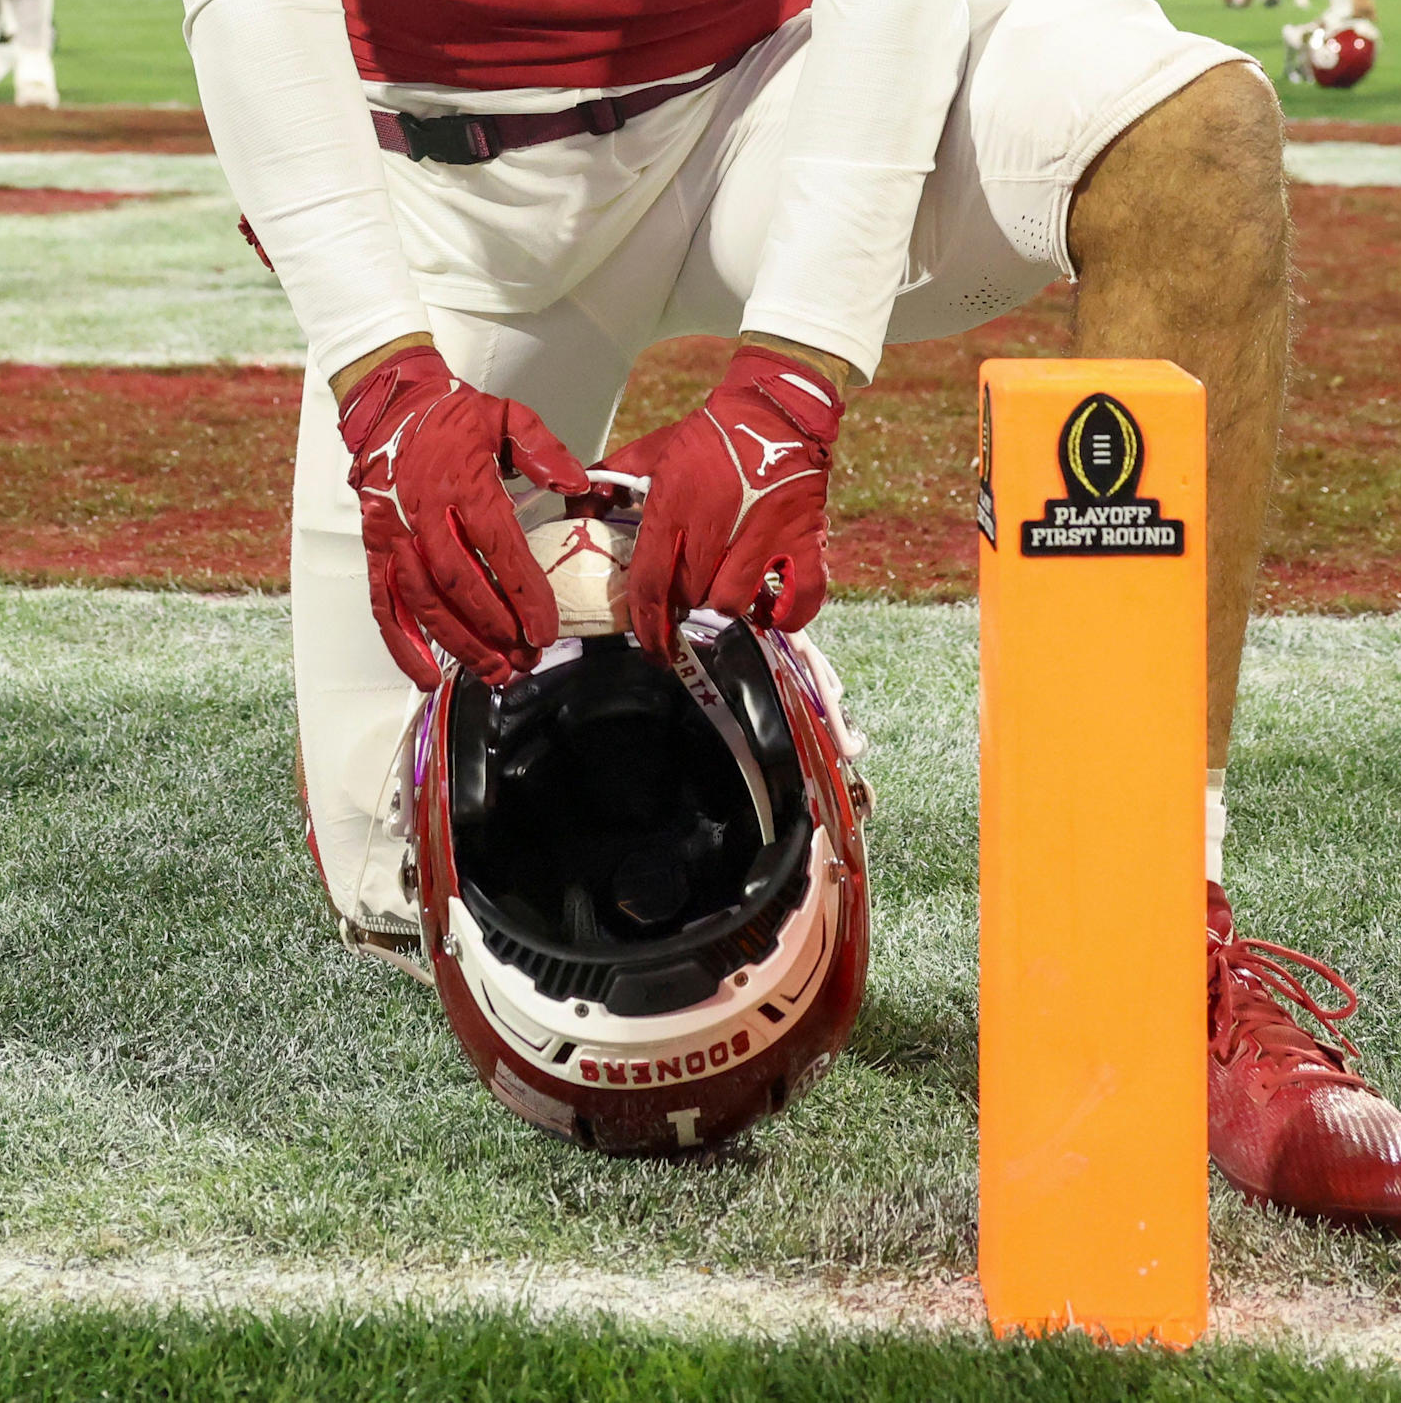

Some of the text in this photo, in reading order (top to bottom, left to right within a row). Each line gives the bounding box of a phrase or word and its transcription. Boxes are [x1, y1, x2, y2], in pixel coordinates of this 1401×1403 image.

[1053, 506, 1151, 526] PLAYOFF
[1030, 527, 1176, 547] FIRST ROUND
[579, 1030, 751, 1085] SOONERS
[666, 1107, 704, 1147] 1
